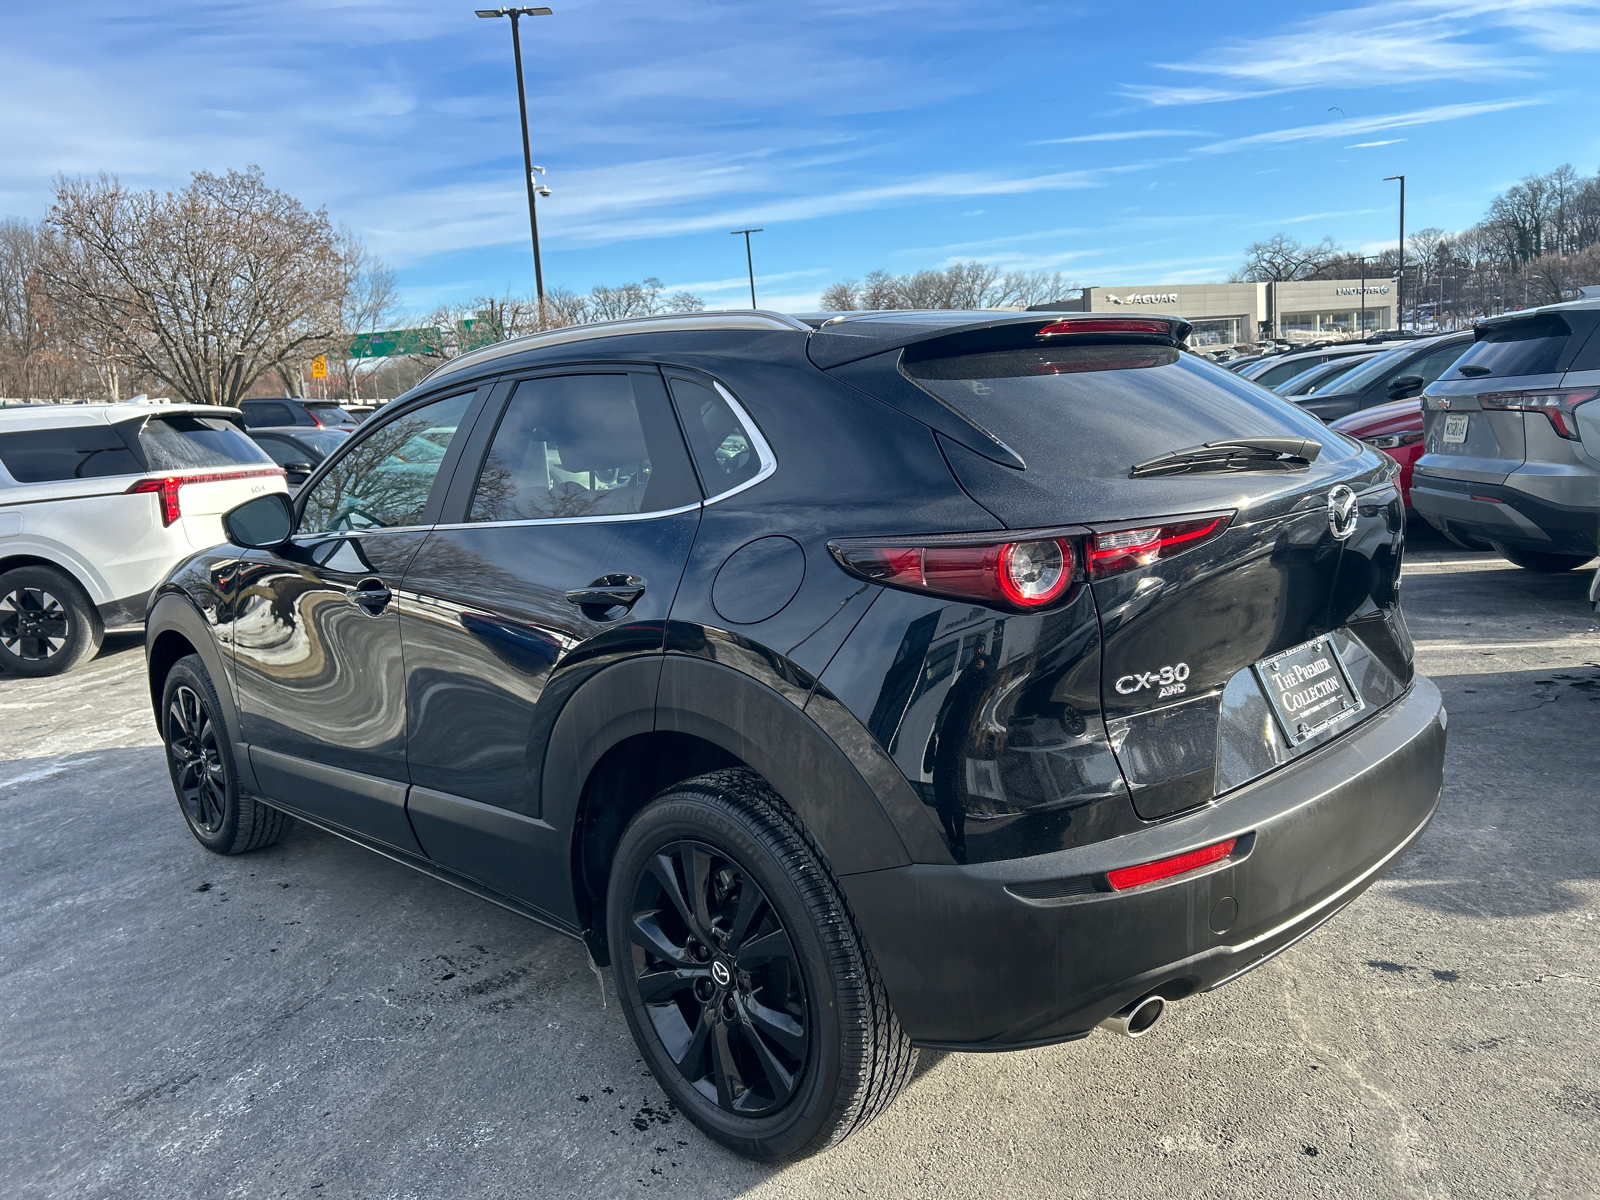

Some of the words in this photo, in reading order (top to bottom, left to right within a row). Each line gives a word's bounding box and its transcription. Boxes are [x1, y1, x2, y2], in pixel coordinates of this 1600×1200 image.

[1124, 292, 1178, 305] JAGUAR
[1336, 287, 1356, 296] LAND
[251, 485, 266, 493] KIA
[1115, 662, 1190, 694] CX-30
[1272, 672, 1299, 692] THE
[1292, 657, 1332, 683] PREMIER
[1158, 682, 1187, 699] AWD
[1282, 675, 1340, 712] COLLECTION
